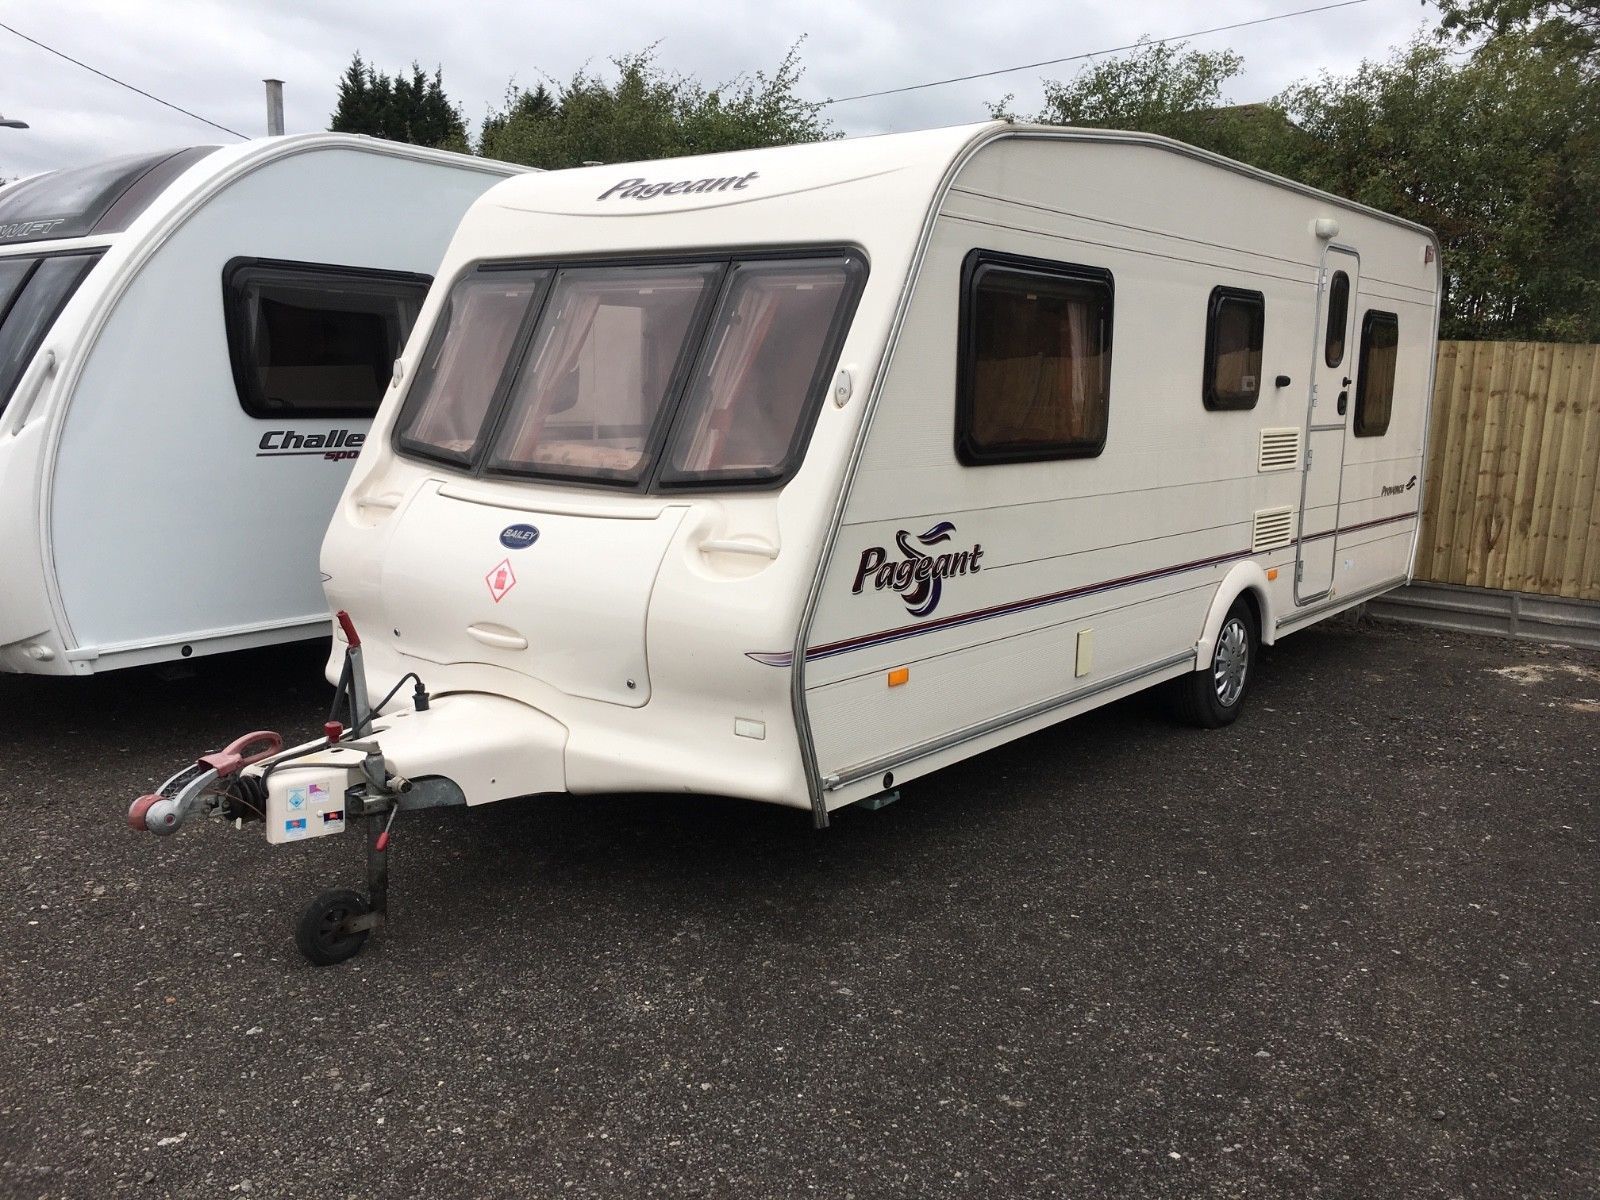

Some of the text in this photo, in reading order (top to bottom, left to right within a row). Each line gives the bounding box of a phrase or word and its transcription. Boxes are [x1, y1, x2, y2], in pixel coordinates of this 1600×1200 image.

[596, 171, 760, 201] Pageant
[503, 528, 538, 540] BAILEY
[851, 543, 984, 595] Pageant
